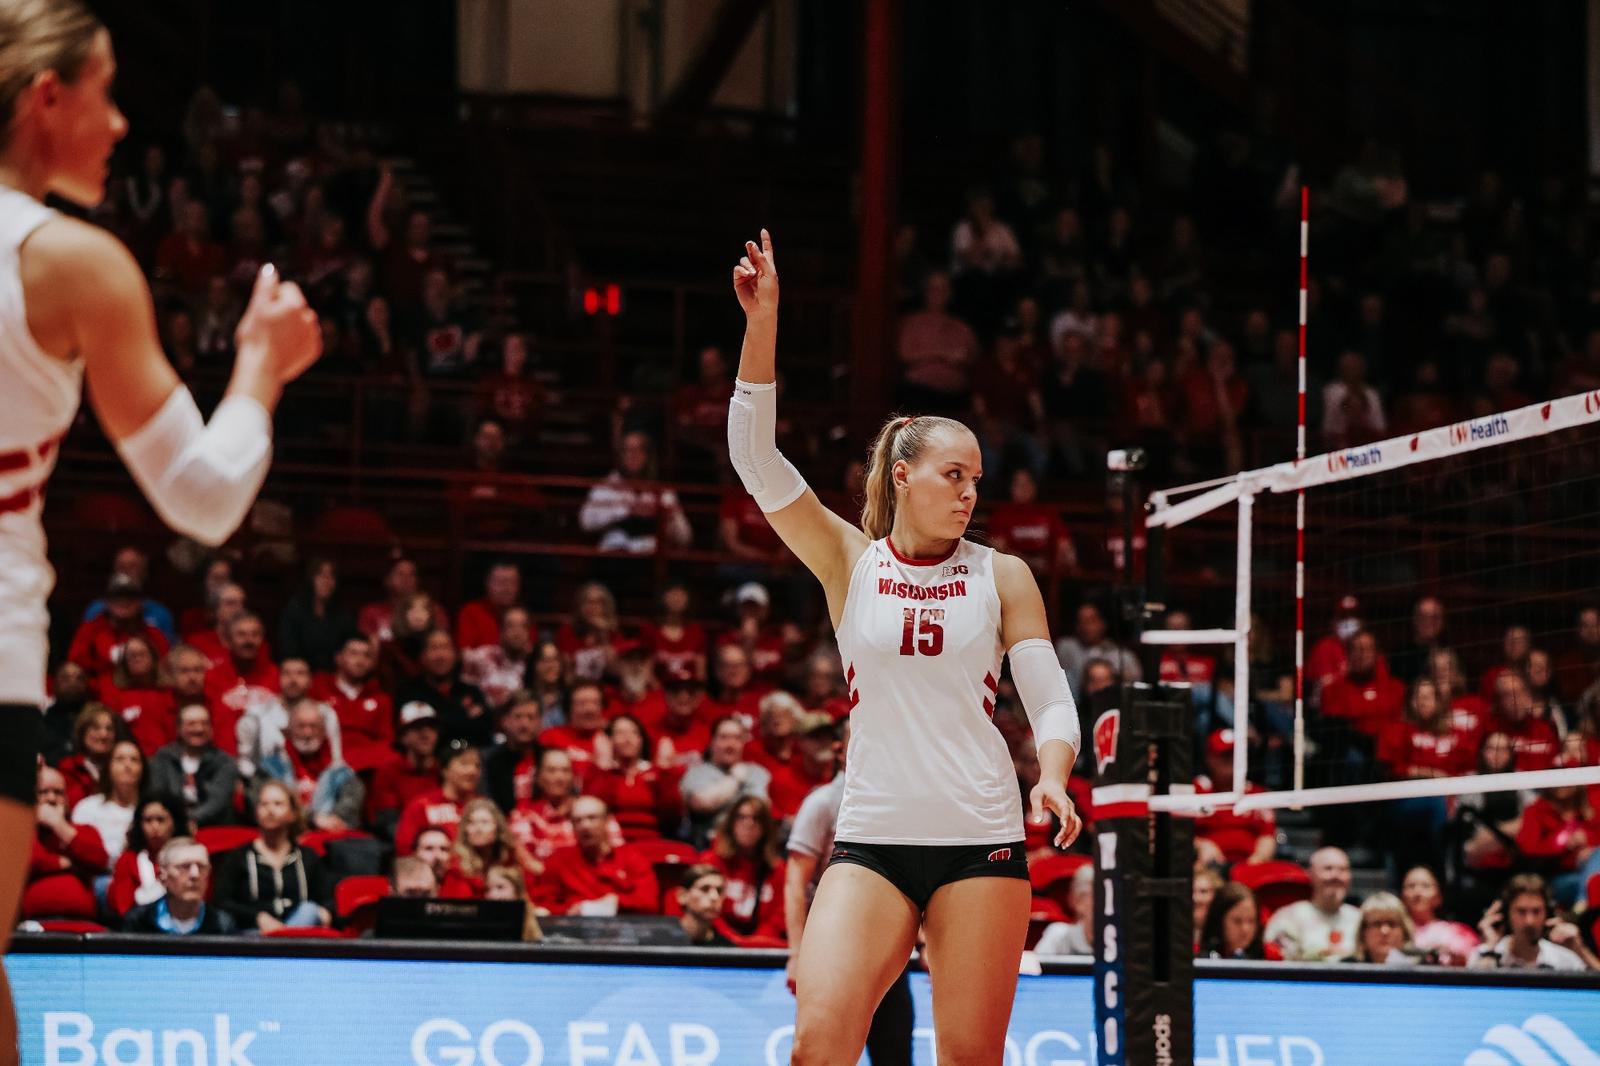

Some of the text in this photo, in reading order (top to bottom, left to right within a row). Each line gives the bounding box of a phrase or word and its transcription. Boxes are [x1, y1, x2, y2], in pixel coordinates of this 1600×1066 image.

[1470, 414, 1510, 442] Health
[878, 577, 967, 601] WISCONSIN
[899, 607, 946, 657] 15
[411, 1017, 545, 1066] GO
